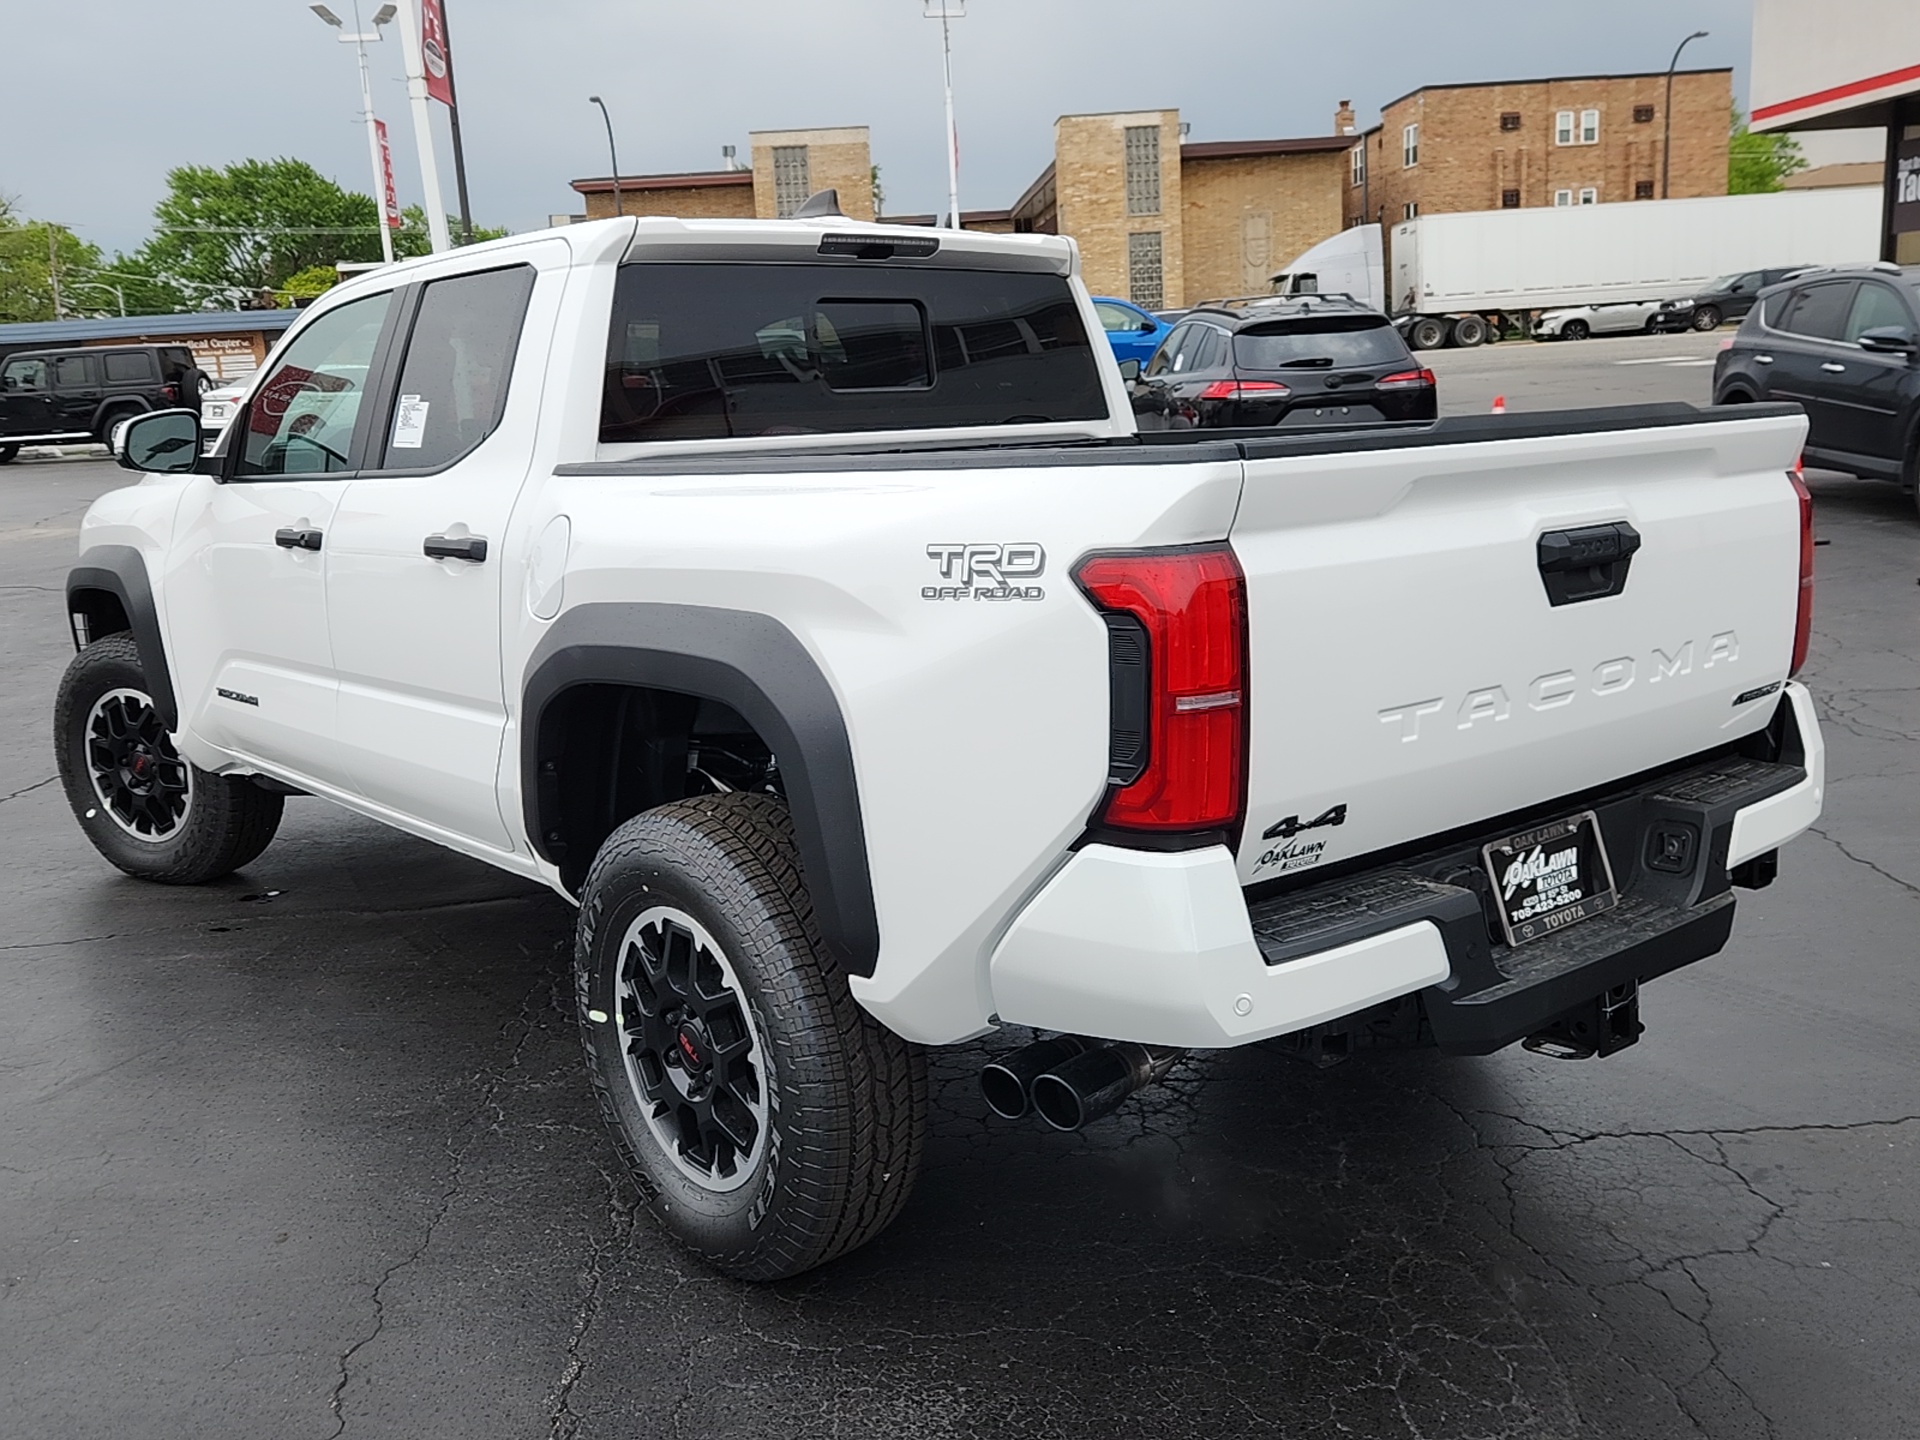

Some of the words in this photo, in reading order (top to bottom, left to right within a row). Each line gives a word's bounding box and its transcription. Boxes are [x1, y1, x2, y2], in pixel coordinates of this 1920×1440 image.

[926, 542, 1047, 588] TRD
[921, 586, 970, 601] OFF
[973, 586, 1045, 601] ROAD
[1377, 629, 1740, 744] TACOMA
[1513, 834, 1535, 850] OAK
[1536, 823, 1566, 844] LAWN
[1541, 868, 1574, 889] TOYOTA
[1511, 889, 1582, 922] 708-423-5200
[1543, 905, 1585, 930] TOYOTA
